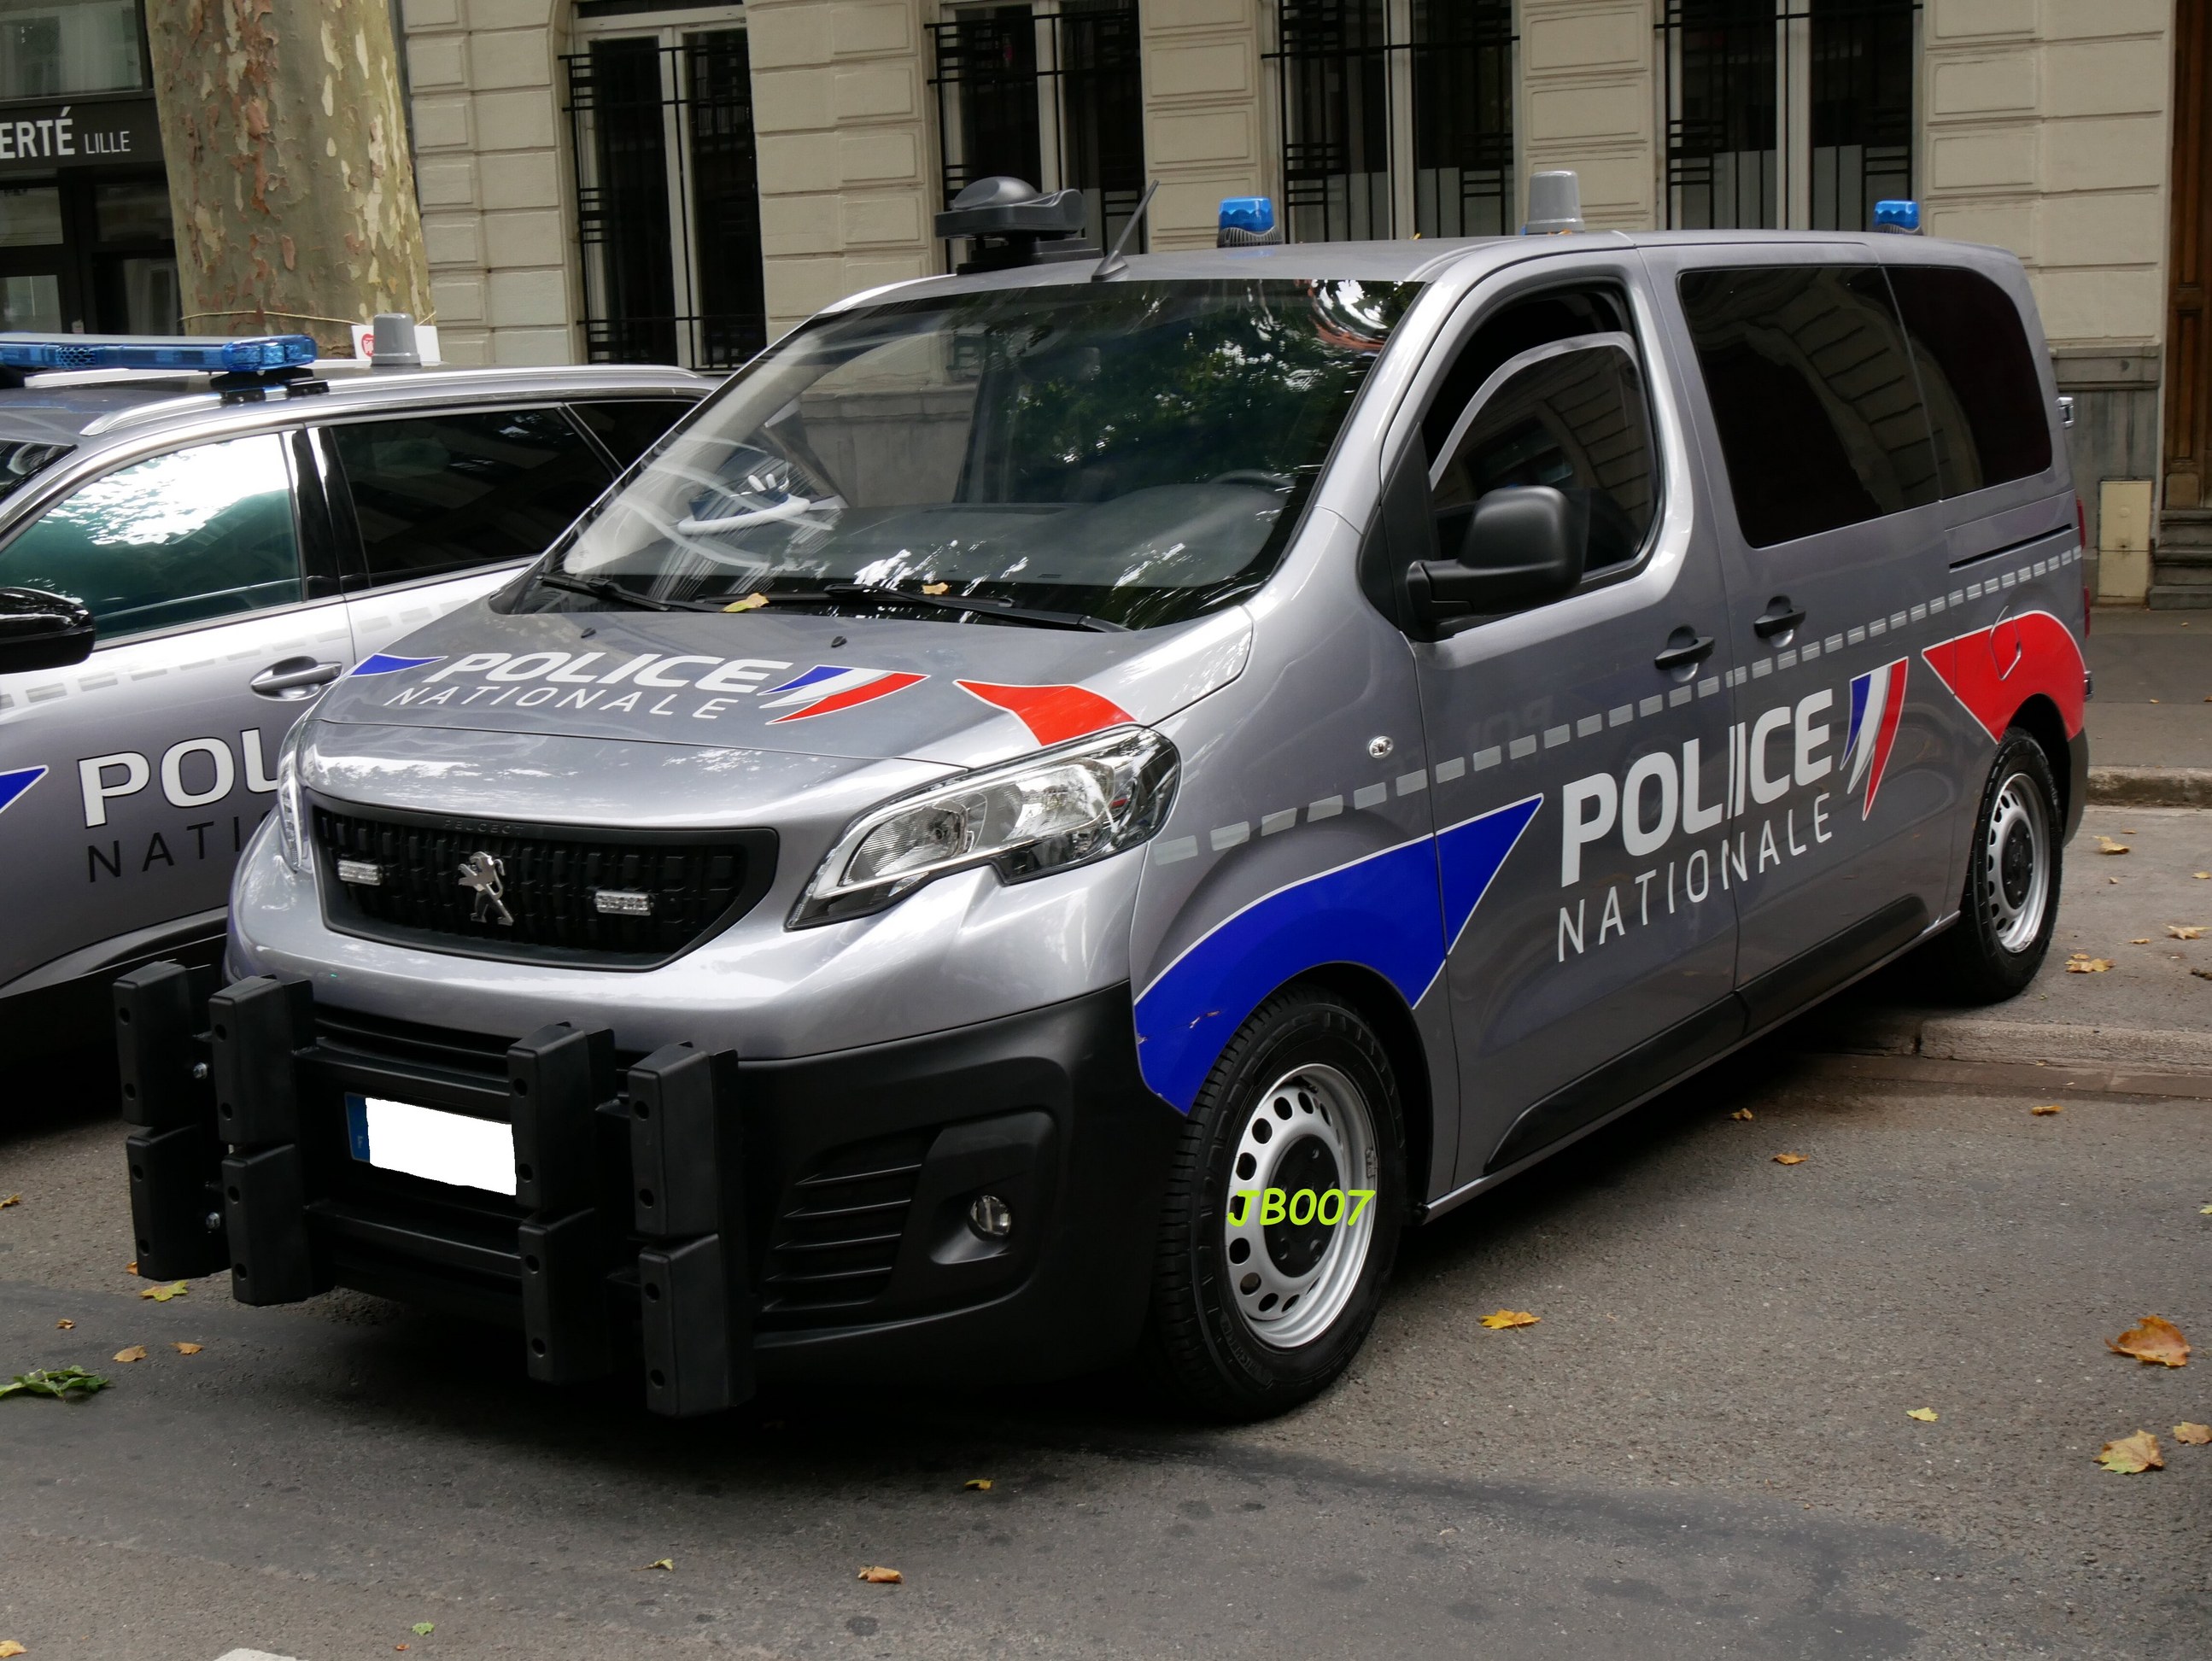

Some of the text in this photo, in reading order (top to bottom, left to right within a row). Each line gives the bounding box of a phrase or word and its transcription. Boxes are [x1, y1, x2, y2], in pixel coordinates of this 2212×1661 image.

[0, 106, 131, 160] ERTÉ LILLE
[383, 686, 740, 720] NATIONALE
[423, 652, 793, 693] POLICE
[1561, 688, 1834, 888] POLICE
[87, 810, 272, 883] NATI
[1558, 792, 1833, 962] NATIONALE
